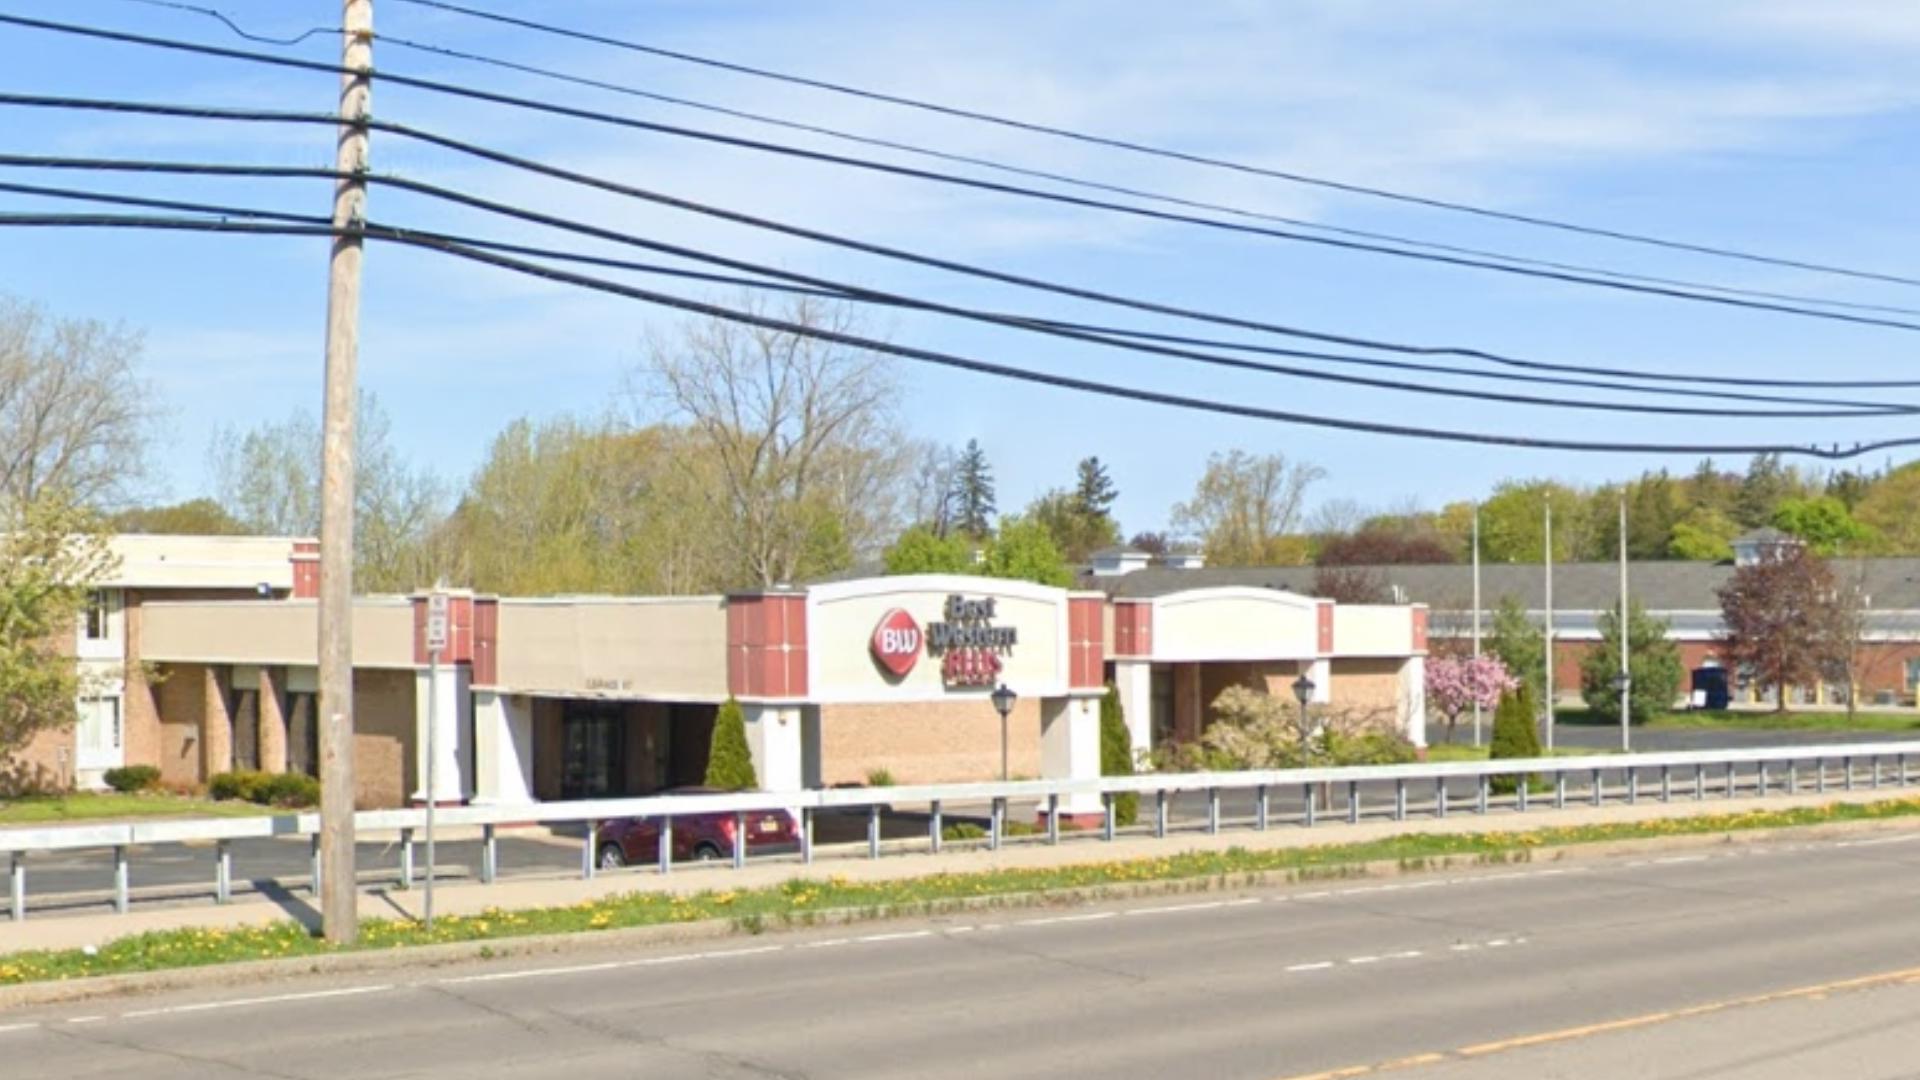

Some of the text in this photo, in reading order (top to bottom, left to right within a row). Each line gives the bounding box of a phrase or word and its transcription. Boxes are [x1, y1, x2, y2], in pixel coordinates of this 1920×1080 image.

[948, 594, 996, 618] Best
[882, 628, 917, 653] BW
[931, 623, 1017, 646] Western
